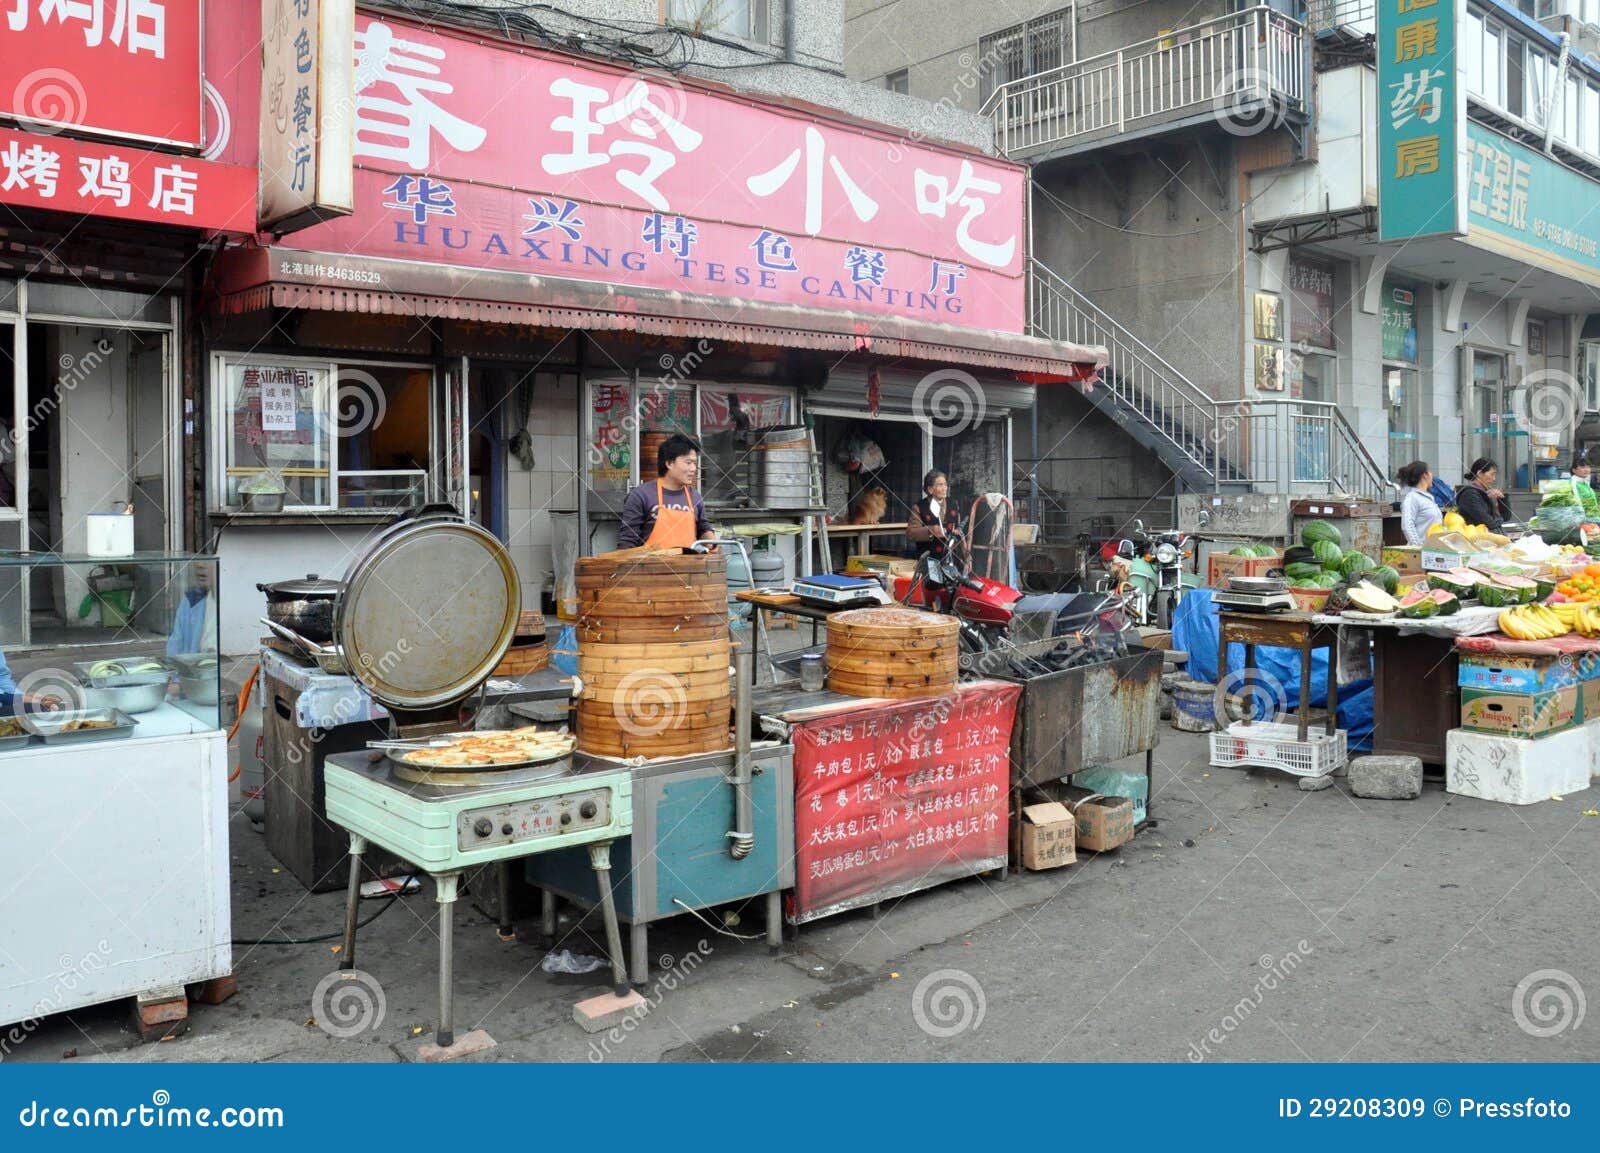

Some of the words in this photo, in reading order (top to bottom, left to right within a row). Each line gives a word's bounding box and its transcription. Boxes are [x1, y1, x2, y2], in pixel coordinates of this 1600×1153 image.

[1389, 0, 1447, 178] 康药房
[1, 140, 198, 215] 烤鸡店
[353, 22, 1016, 267] 春玲小吃
[1467, 138, 1532, 231] 王星辰
[383, 175, 968, 295] 华兴特色餐厅
[393, 220, 648, 272] HUAXING
[674, 257, 777, 289] TESE
[801, 276, 964, 314] CANTING
